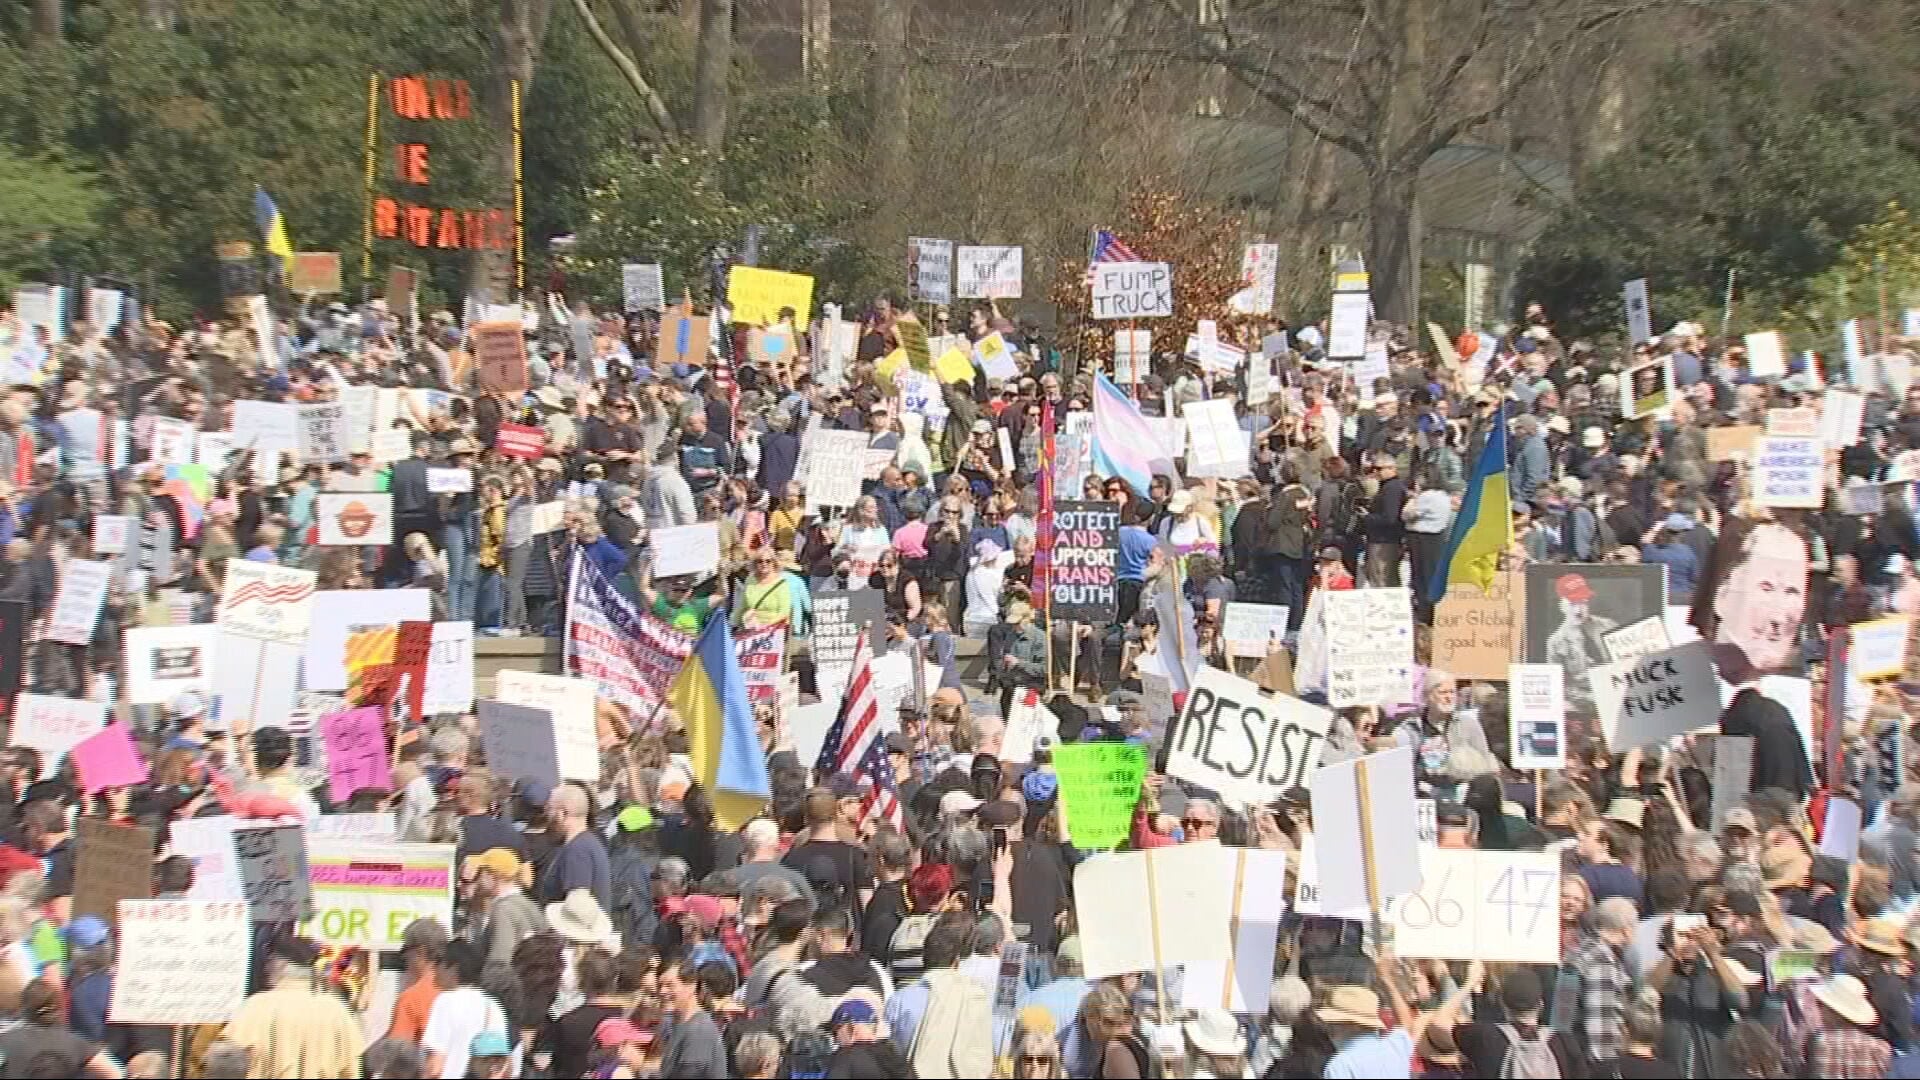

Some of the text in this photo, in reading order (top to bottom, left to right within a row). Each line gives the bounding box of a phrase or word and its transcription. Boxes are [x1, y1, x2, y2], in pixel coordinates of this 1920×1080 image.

[1104, 269, 1165, 291] FUMP
[1095, 289, 1170, 315] TRUCK
[1053, 511, 1118, 530] ROTECT
[1055, 530, 1104, 548] AND
[1051, 548, 1118, 566] UPPORT
[812, 598, 849, 611] HOPE
[815, 611, 848, 624] THAT
[1437, 610, 1514, 627] our Global
[815, 624, 856, 636] COSTS
[1446, 634, 1476, 661] good
[1611, 658, 1680, 688] MUCK
[1624, 686, 1685, 719] FUSK
[331, 714, 370, 753] 86
[1177, 688, 1324, 787] RESIST
[335, 753, 375, 790] 47
[1486, 865, 1557, 938] 47
[122, 903, 247, 923] HANDS OFF
